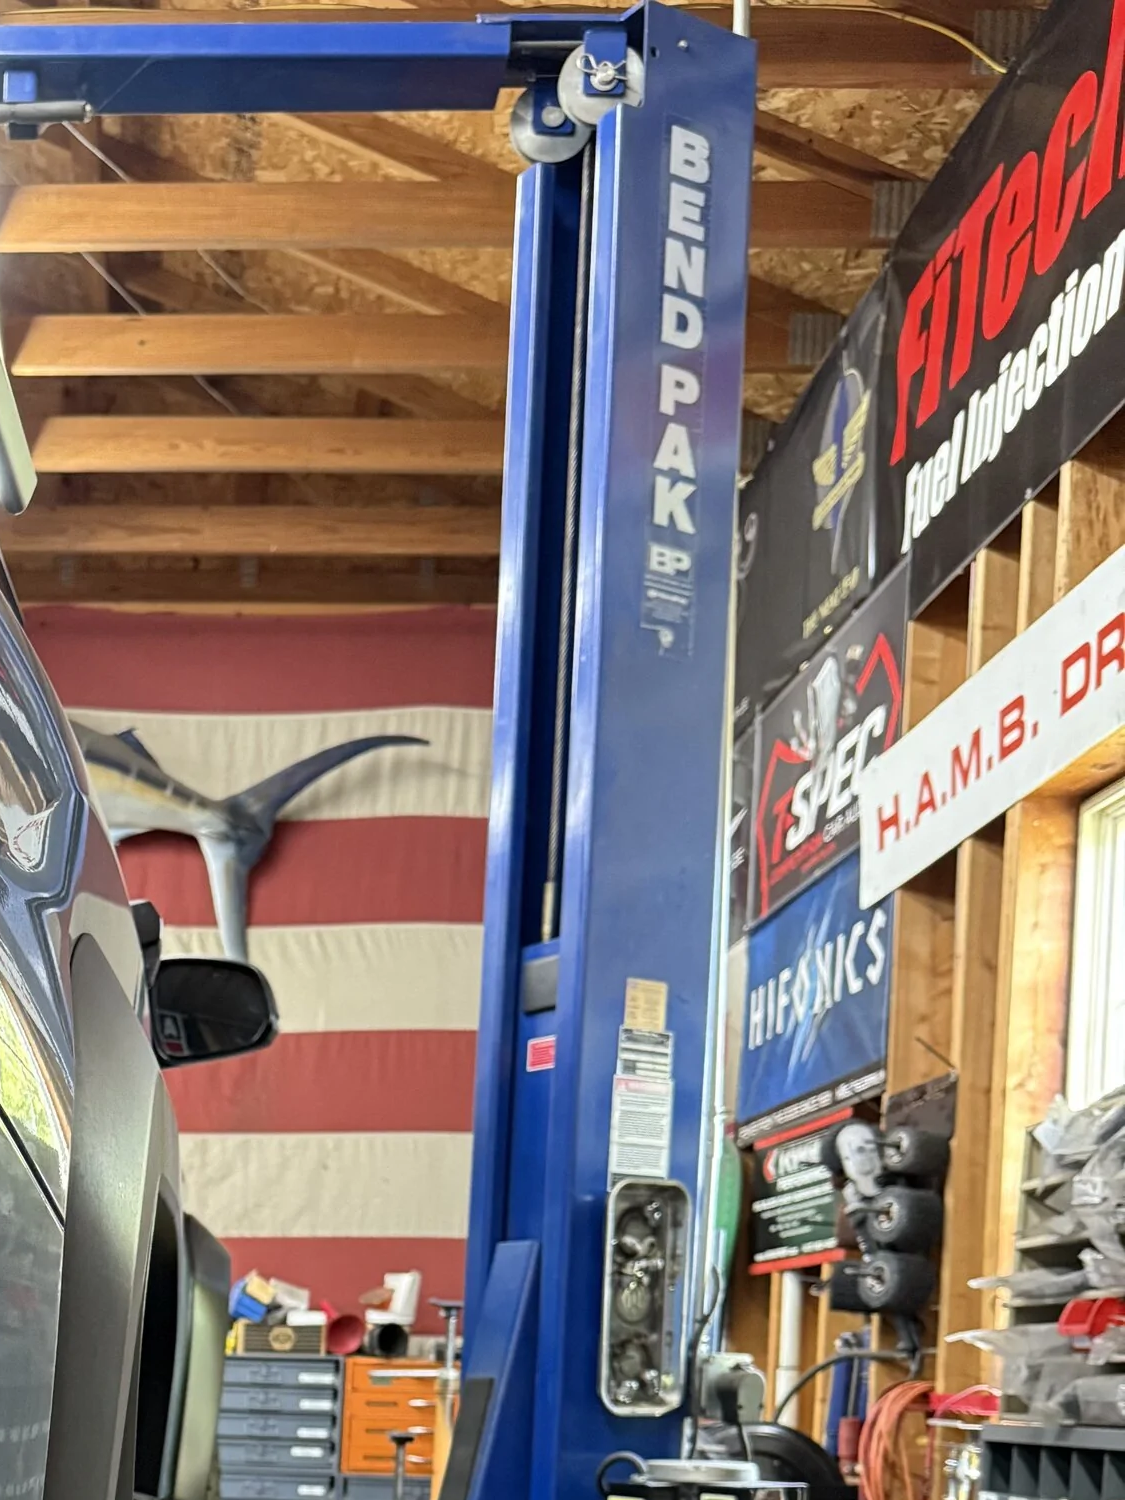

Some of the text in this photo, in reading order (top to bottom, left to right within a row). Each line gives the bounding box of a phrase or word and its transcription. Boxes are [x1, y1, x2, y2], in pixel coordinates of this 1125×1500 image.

[960, 228, 1125, 485] Injection
[785, 704, 887, 851] SPEC
[877, 695, 1039, 852] H.A.M.B.
[748, 908, 887, 1051] HIFONICS
